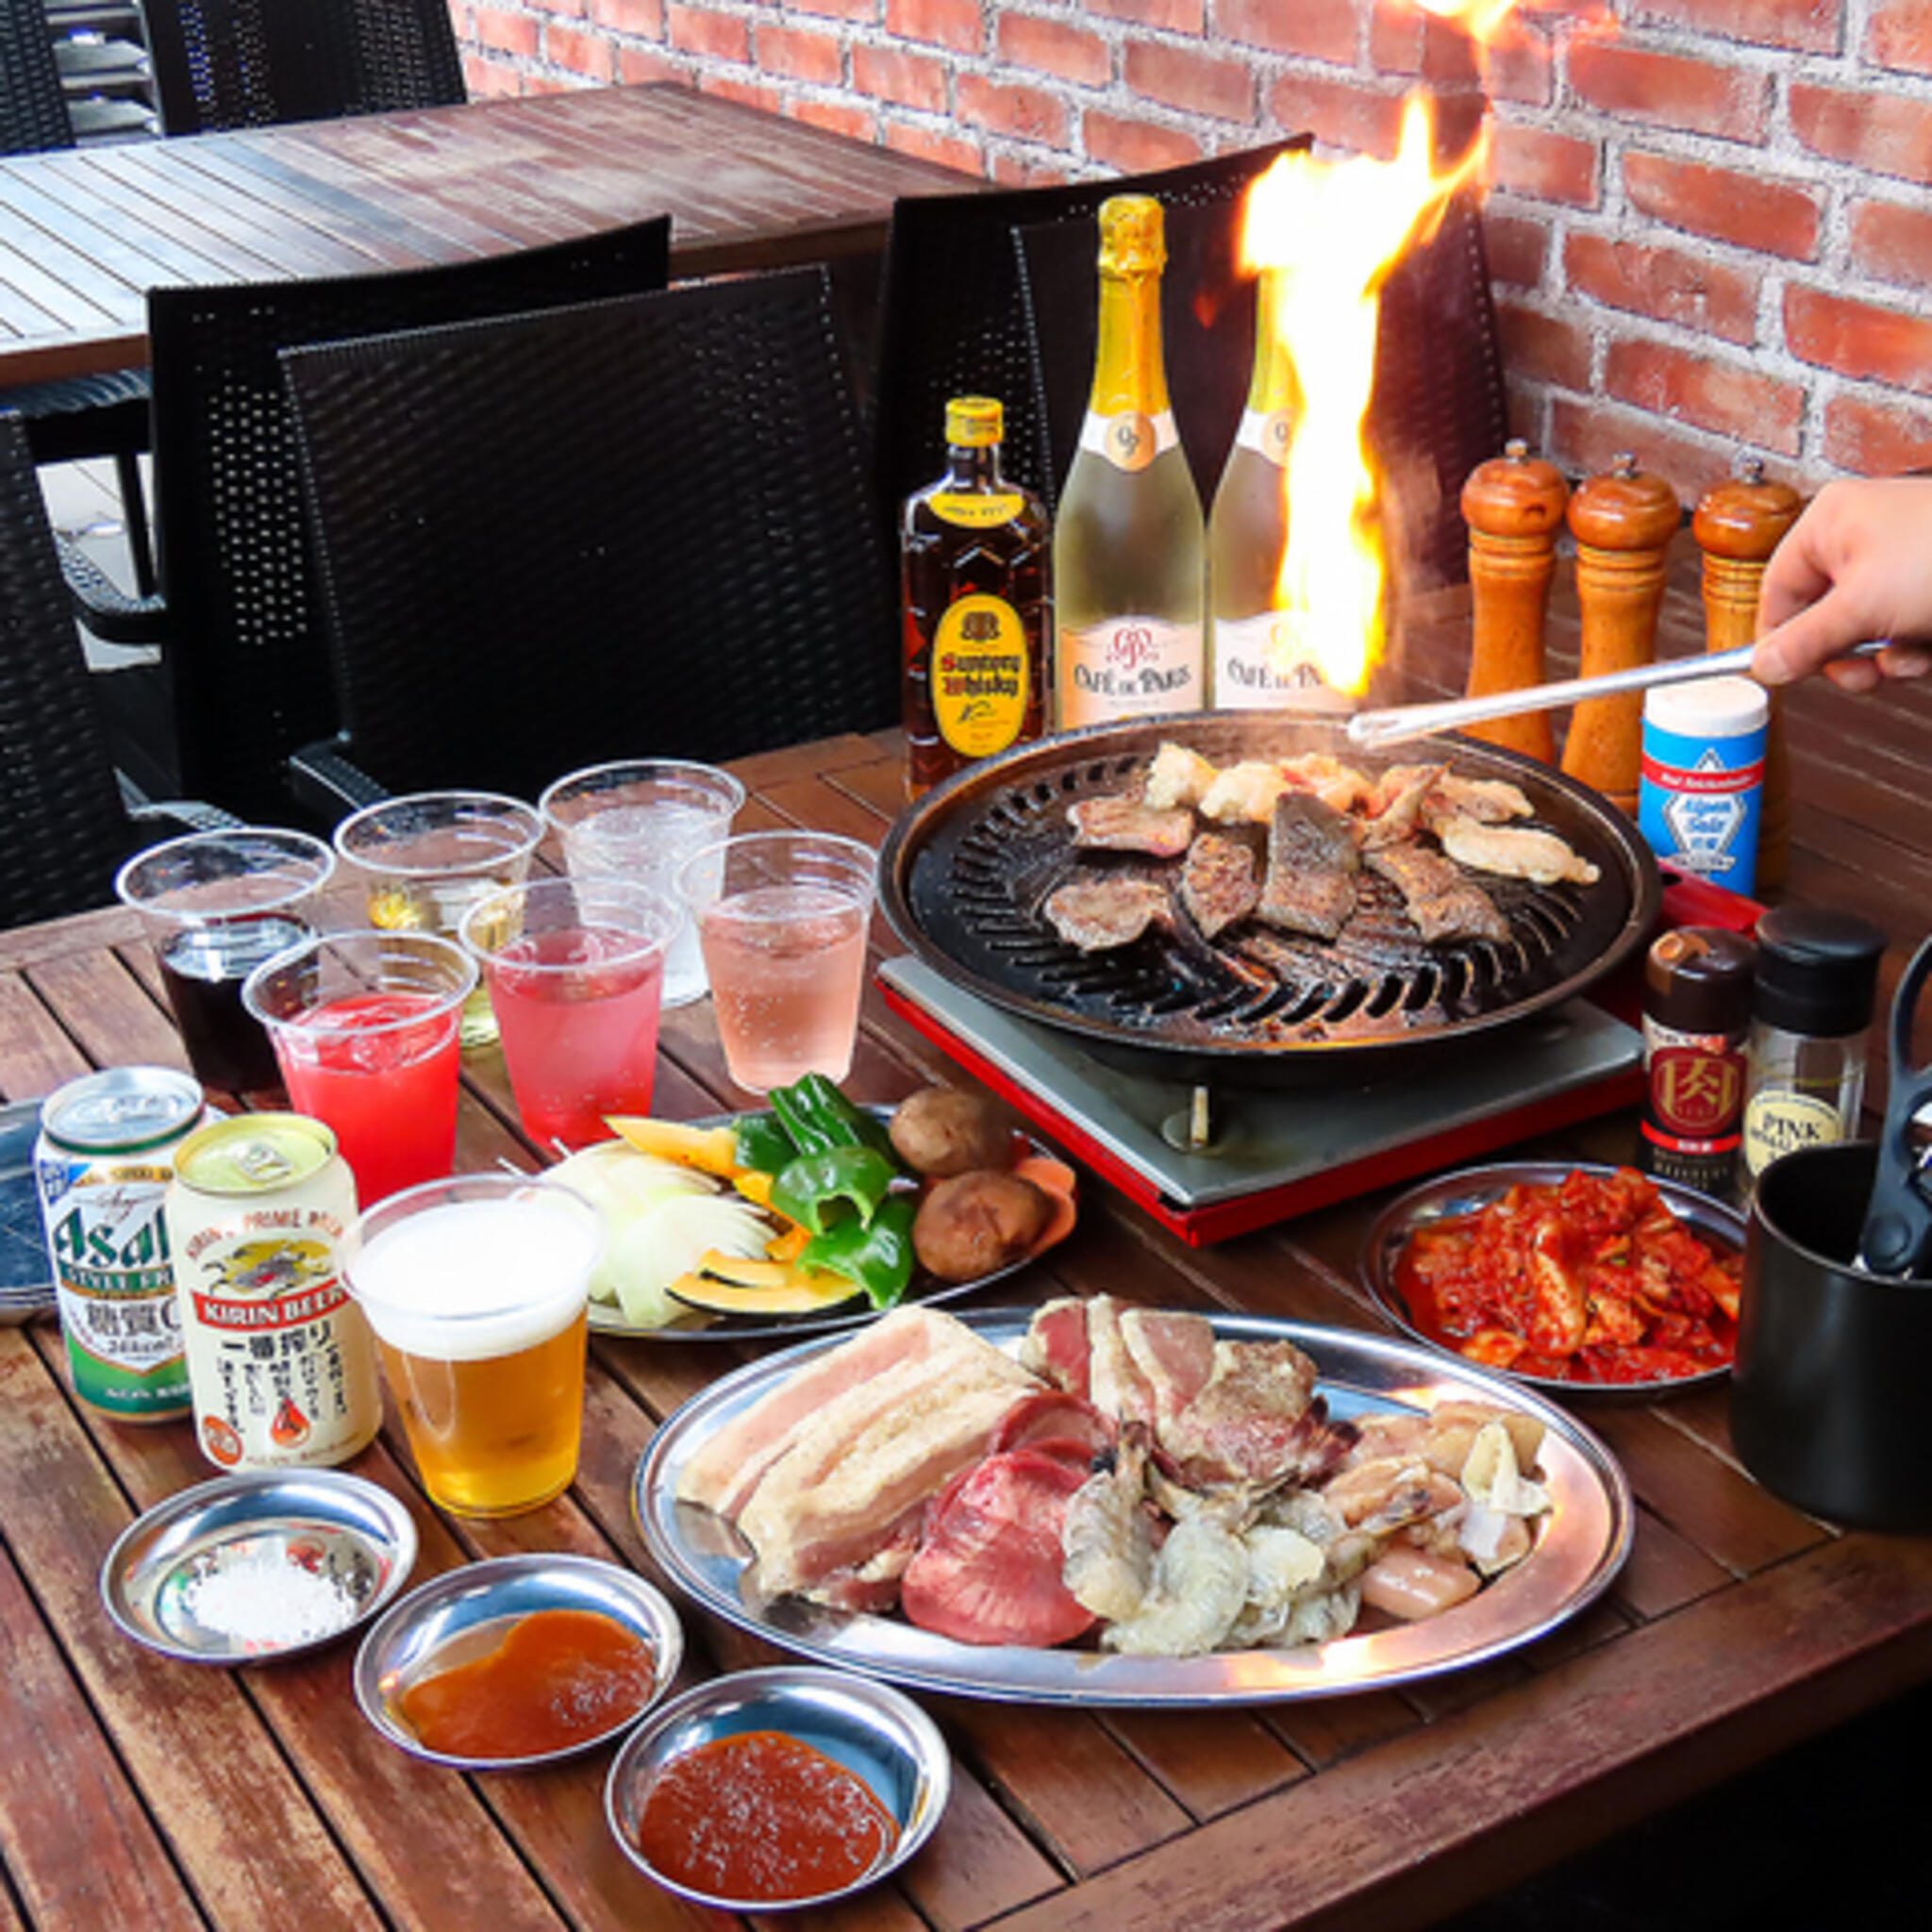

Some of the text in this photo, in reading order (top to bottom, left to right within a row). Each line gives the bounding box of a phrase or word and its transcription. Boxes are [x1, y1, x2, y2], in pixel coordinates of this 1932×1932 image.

[941, 652, 1022, 673] Suntory
[942, 674, 1019, 700] Whisky
[1661, 1058, 1738, 1117] 肉
[1762, 1111, 1820, 1141] PINK
[53, 1206, 171, 1268] Asa
[204, 1286, 346, 1325] KIRIN BEER
